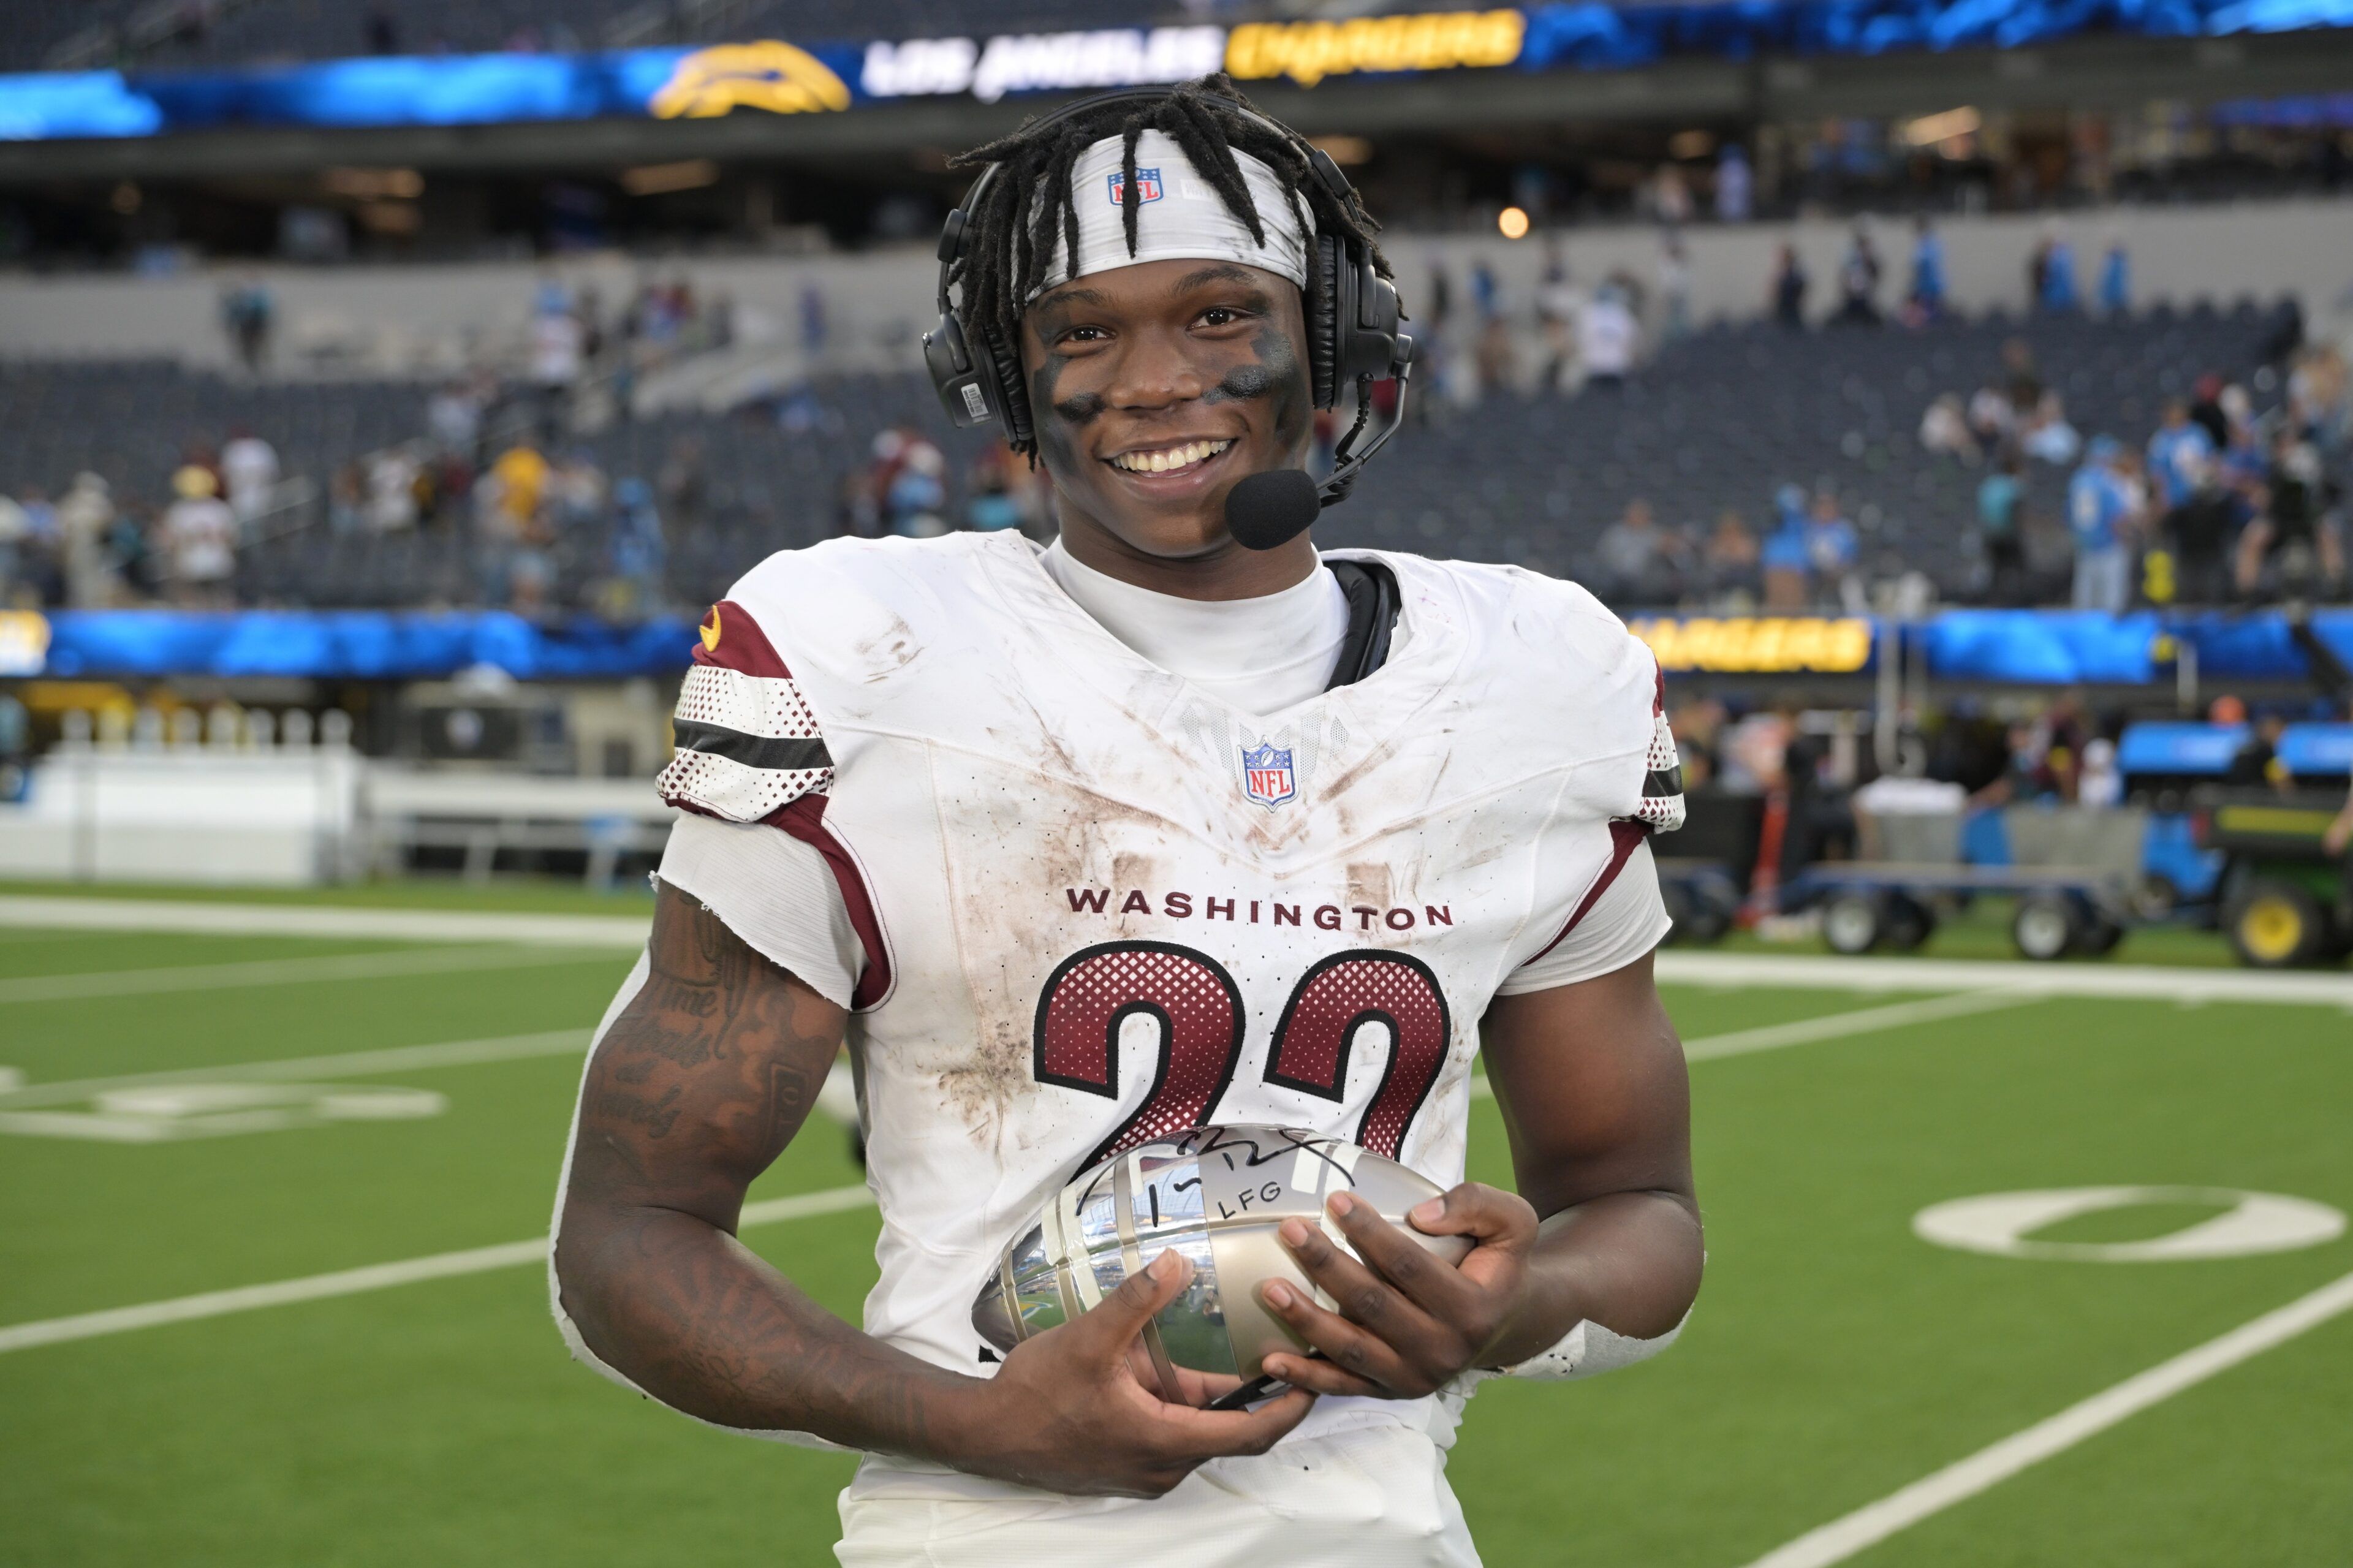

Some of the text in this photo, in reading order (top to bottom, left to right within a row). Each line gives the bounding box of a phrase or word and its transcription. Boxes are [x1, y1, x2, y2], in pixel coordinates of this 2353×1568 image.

[1249, 770, 1290, 798] NFL
[1066, 887, 1454, 931] WASHINGTON
[1218, 1181, 1281, 1219] LFG
